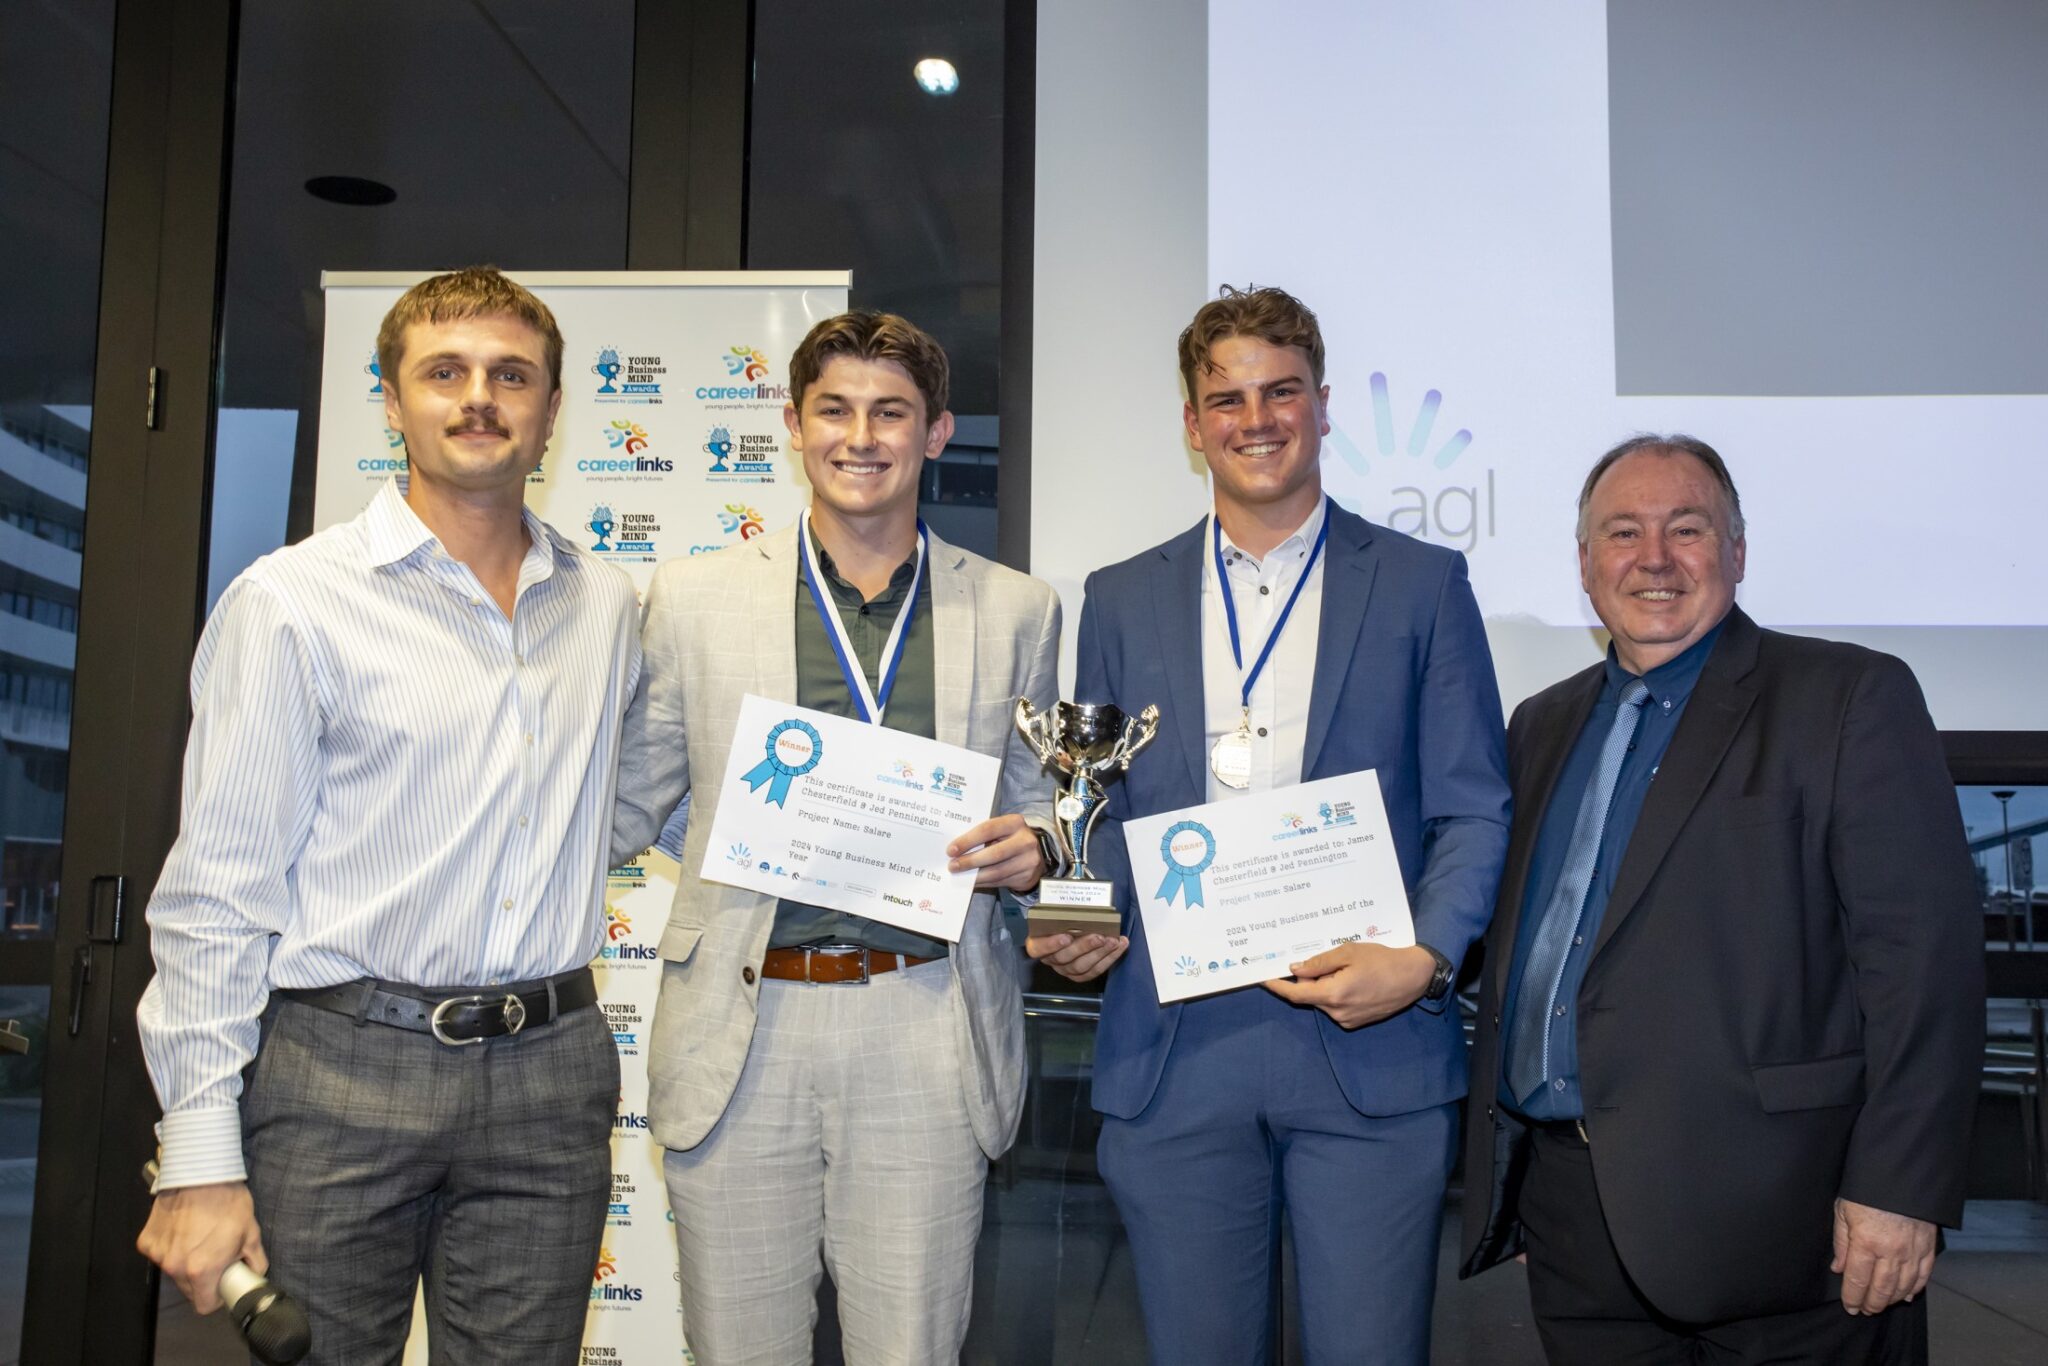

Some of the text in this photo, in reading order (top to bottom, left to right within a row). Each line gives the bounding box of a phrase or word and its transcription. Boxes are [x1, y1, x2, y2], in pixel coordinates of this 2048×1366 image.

[628, 356, 661, 365] YOUNG
[628, 365, 667, 374] Business
[627, 374, 654, 383] MIND
[739, 435, 773, 444] YOUNG
[739, 444, 779, 453] Business
[739, 453, 766, 462] MIND
[577, 456, 674, 472] careerlinks
[1387, 468, 1496, 554] agl
[622, 514, 655, 523] YOUNG
[621, 523, 661, 532] Business
[621, 532, 648, 541] MIND
[778, 738, 811, 753] Winner
[876, 774, 924, 792] careerlinks
[804, 775, 824, 787] This
[826, 780, 874, 799] certificate
[877, 793, 886, 802] is
[888, 796, 927, 812] awarded
[944, 810, 972, 824] James
[801, 787, 857, 807] Chesterfield
[869, 804, 886, 815] Jed
[888, 808, 941, 828] Pennington
[798, 809, 892, 839] Project Name: Salare
[1272, 826, 1318, 841] careerlinks
[788, 850, 809, 862] Year
[1210, 864, 1230, 875] This
[1232, 853, 1278, 867] certificate
[1280, 851, 1290, 860] is
[1293, 842, 1330, 857] awarded
[1347, 833, 1374, 846] James
[736, 858, 753, 870] agl
[791, 839, 942, 882] 2024 Young Business Mind of the
[1212, 866, 1267, 885] Chesterfield
[1280, 861, 1295, 872] Jed
[1297, 850, 1348, 868] Pennington
[1219, 893, 1251, 906] Project
[1283, 881, 1311, 894] Salare
[883, 892, 913, 908] intouch
[1226, 898, 1374, 936] 2024 Young Business Mind of the
[1228, 937, 1248, 948] Year
[1331, 933, 1362, 946] intouch
[601, 943, 657, 960] erlinks
[1186, 965, 1202, 977] agl
[602, 1004, 636, 1013] YOUNG
[609, 1023, 629, 1032] IND
[589, 1284, 643, 1301] erlinks
[582, 1347, 617, 1356] YOUNG
[582, 1357, 623, 1366] Business
